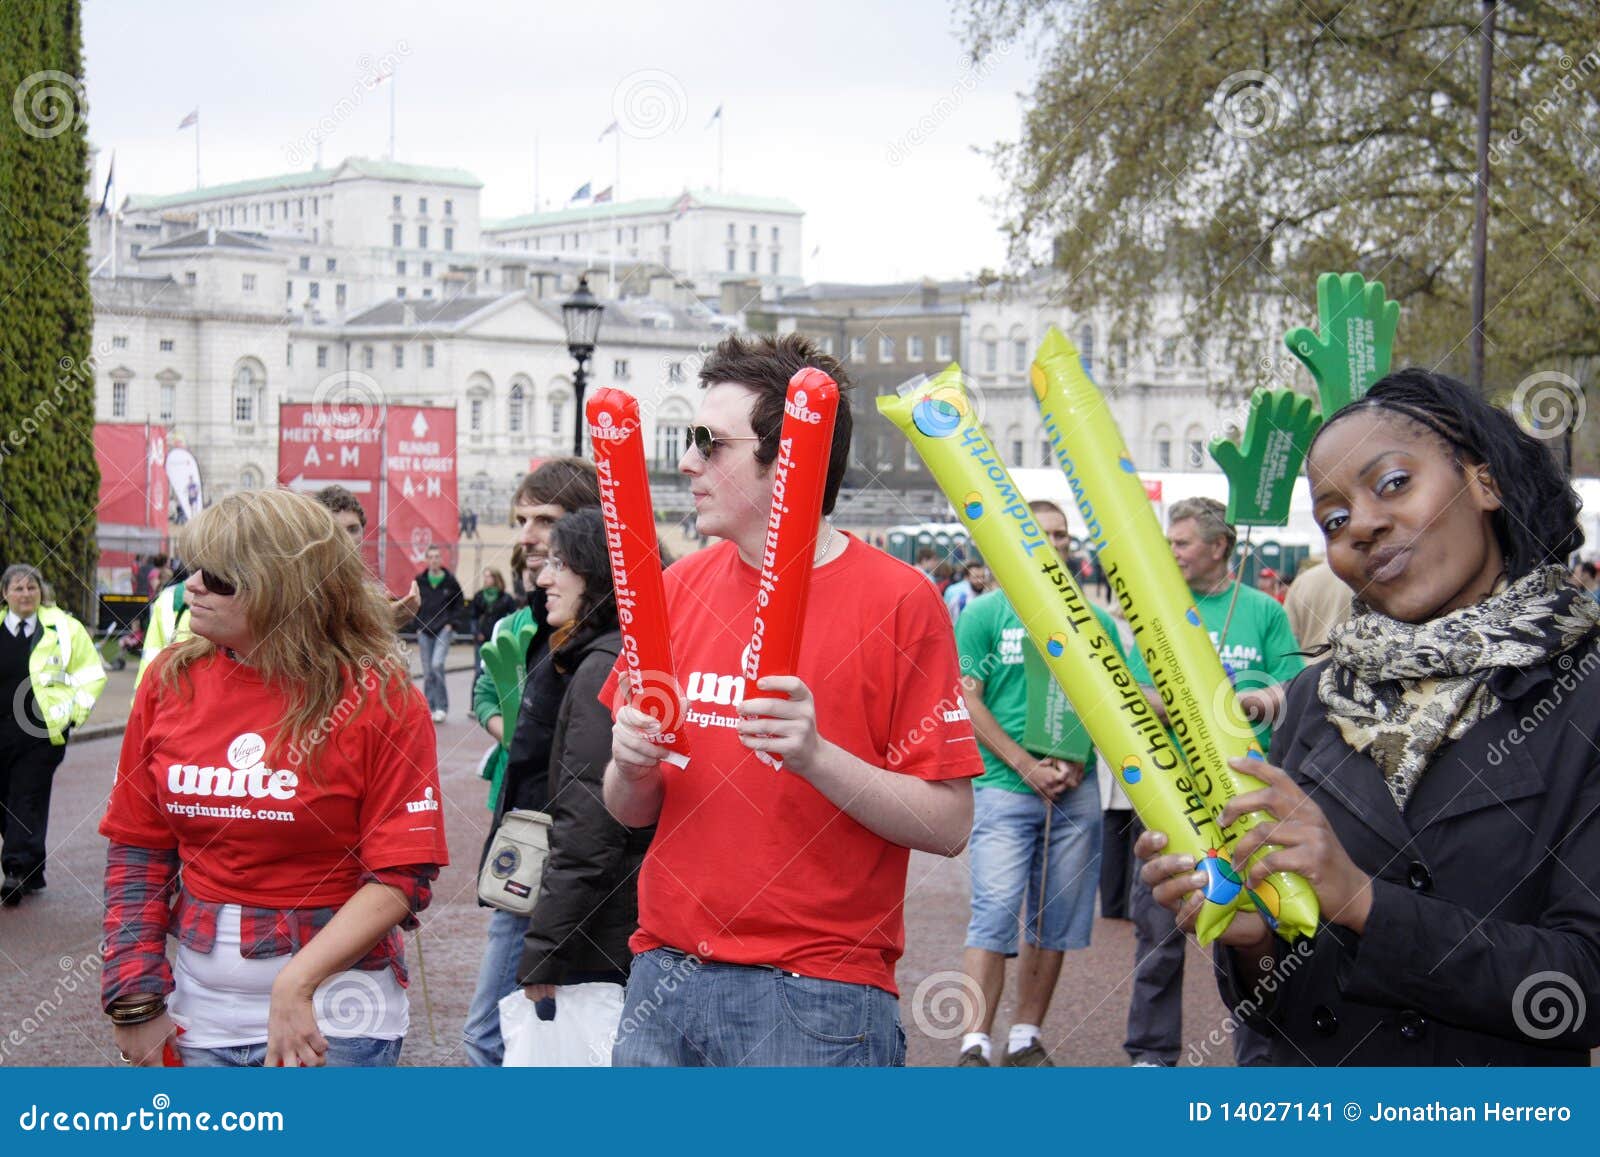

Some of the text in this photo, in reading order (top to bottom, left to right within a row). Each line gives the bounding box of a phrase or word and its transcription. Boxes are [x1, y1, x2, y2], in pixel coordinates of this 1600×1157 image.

[1354, 317, 1368, 398] MACMILLA
[282, 429, 319, 443] MEET
[303, 444, 321, 467] A
[340, 446, 360, 468] M
[388, 457, 413, 471] MEET
[596, 459, 644, 695] virginunite.com
[746, 438, 796, 680] virginunite.com
[960, 427, 1212, 836] The Children's Trust Tadworth
[1151, 618, 1186, 685] disabilities
[1180, 687, 1209, 740] multiple
[231, 738, 262, 764] Virgin
[1204, 741, 1223, 771] with
[167, 762, 299, 800] unite
[166, 803, 295, 822] virginunite.com
